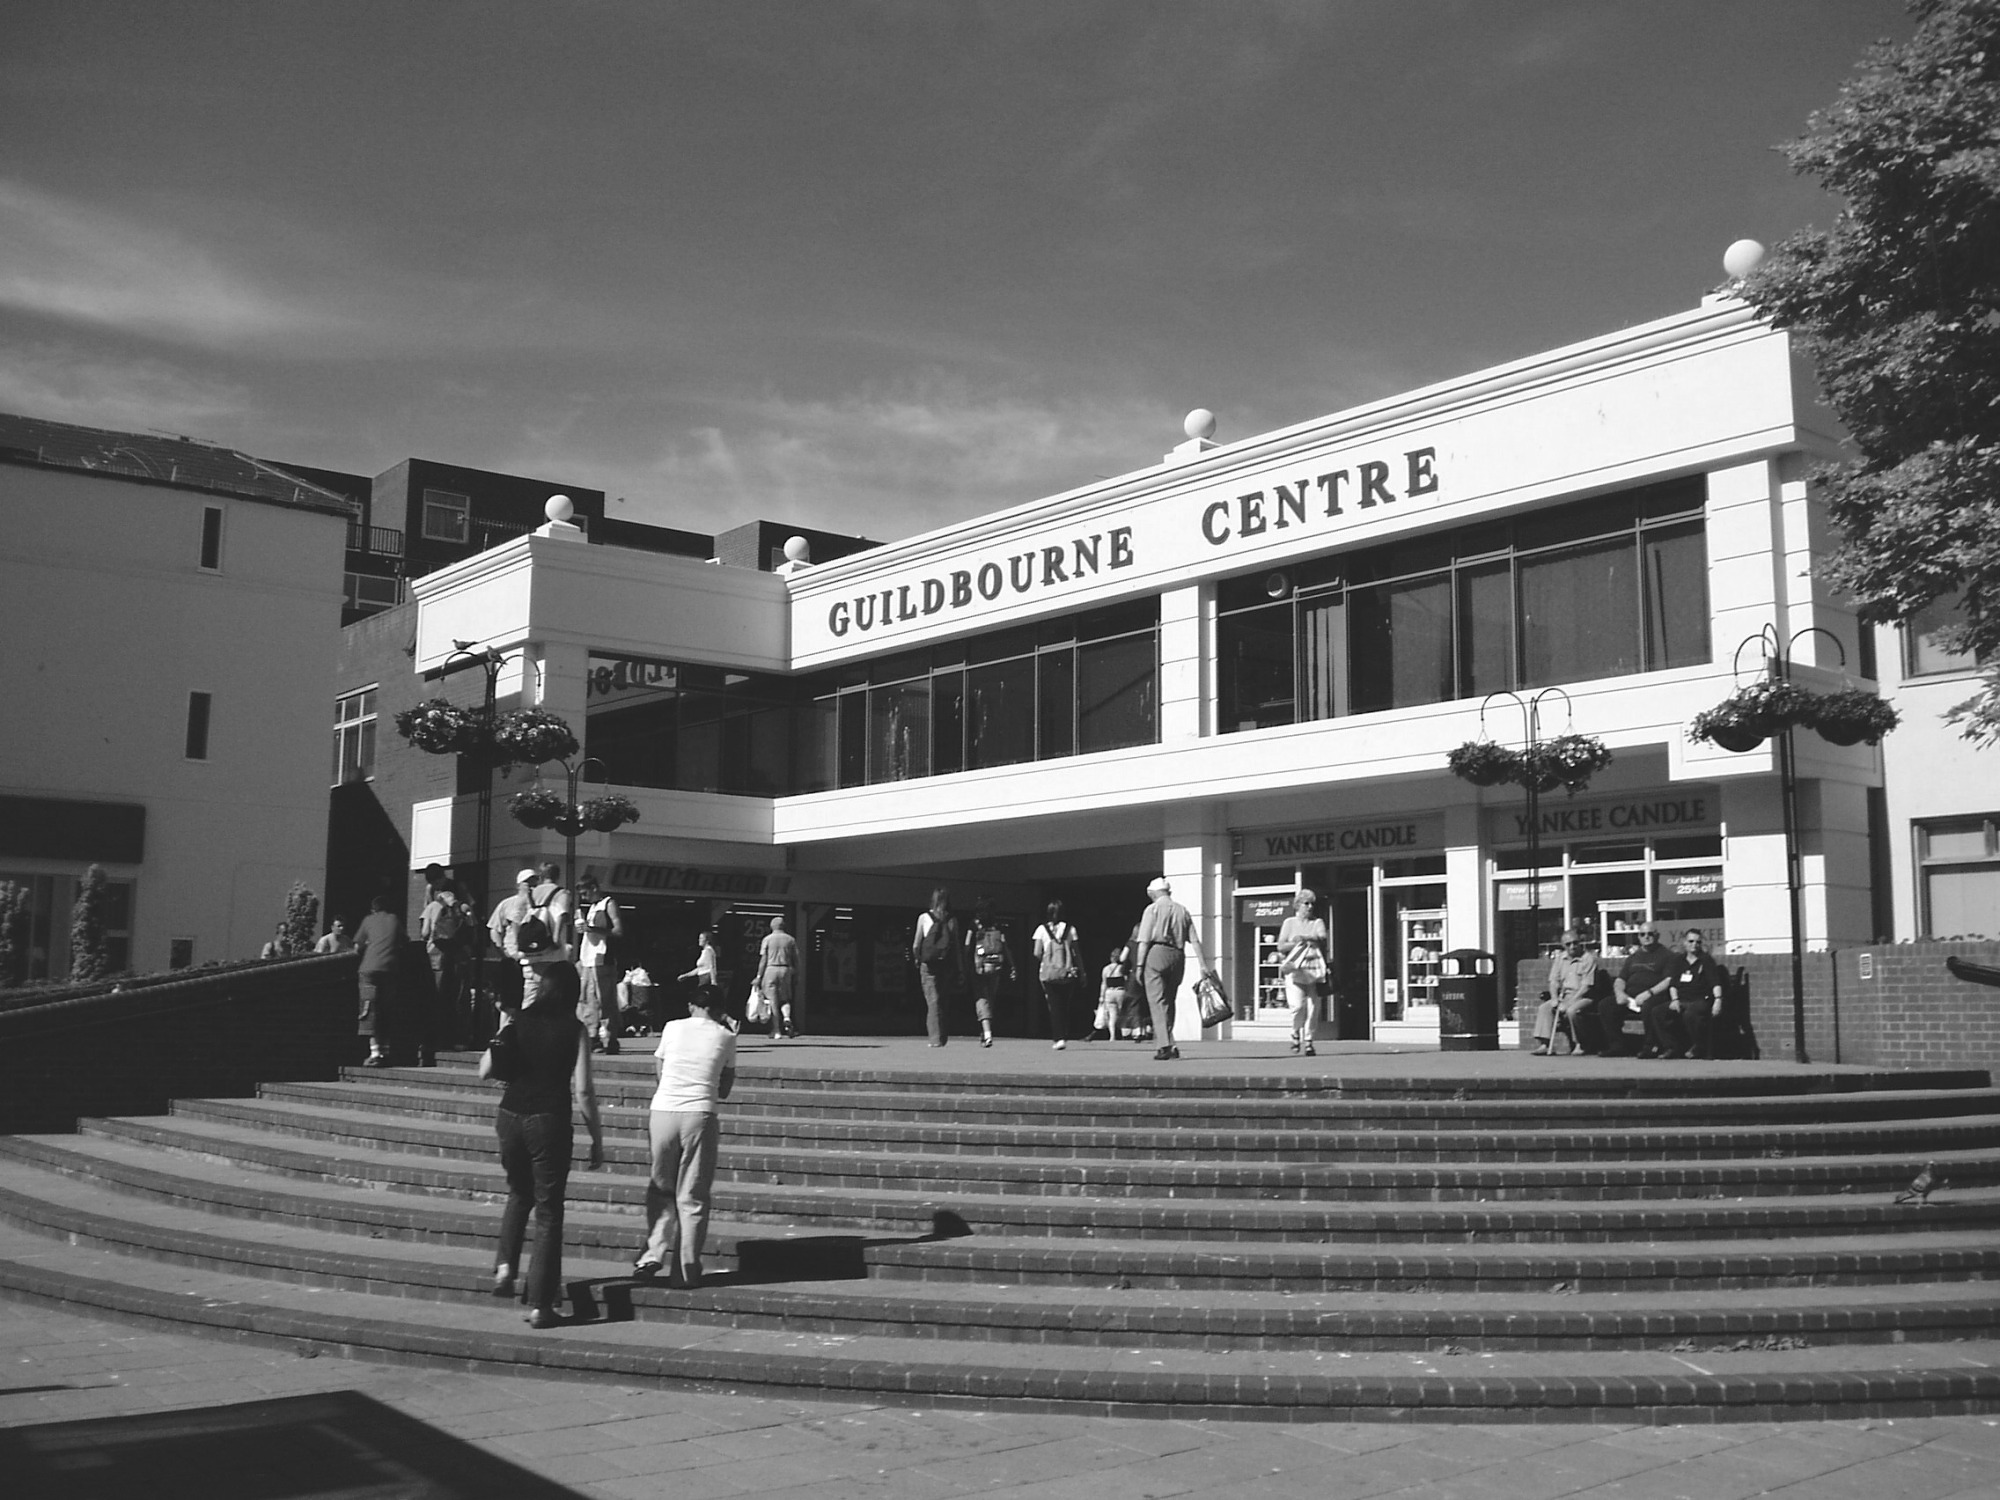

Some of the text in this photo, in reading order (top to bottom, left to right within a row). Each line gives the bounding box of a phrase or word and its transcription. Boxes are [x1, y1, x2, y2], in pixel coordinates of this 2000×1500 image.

[828, 446, 1440, 638] GUILDBOURNE CENTRE
[1609, 800, 1706, 828] CANDLE
[1265, 825, 1417, 855] YANKEE CANDLE
